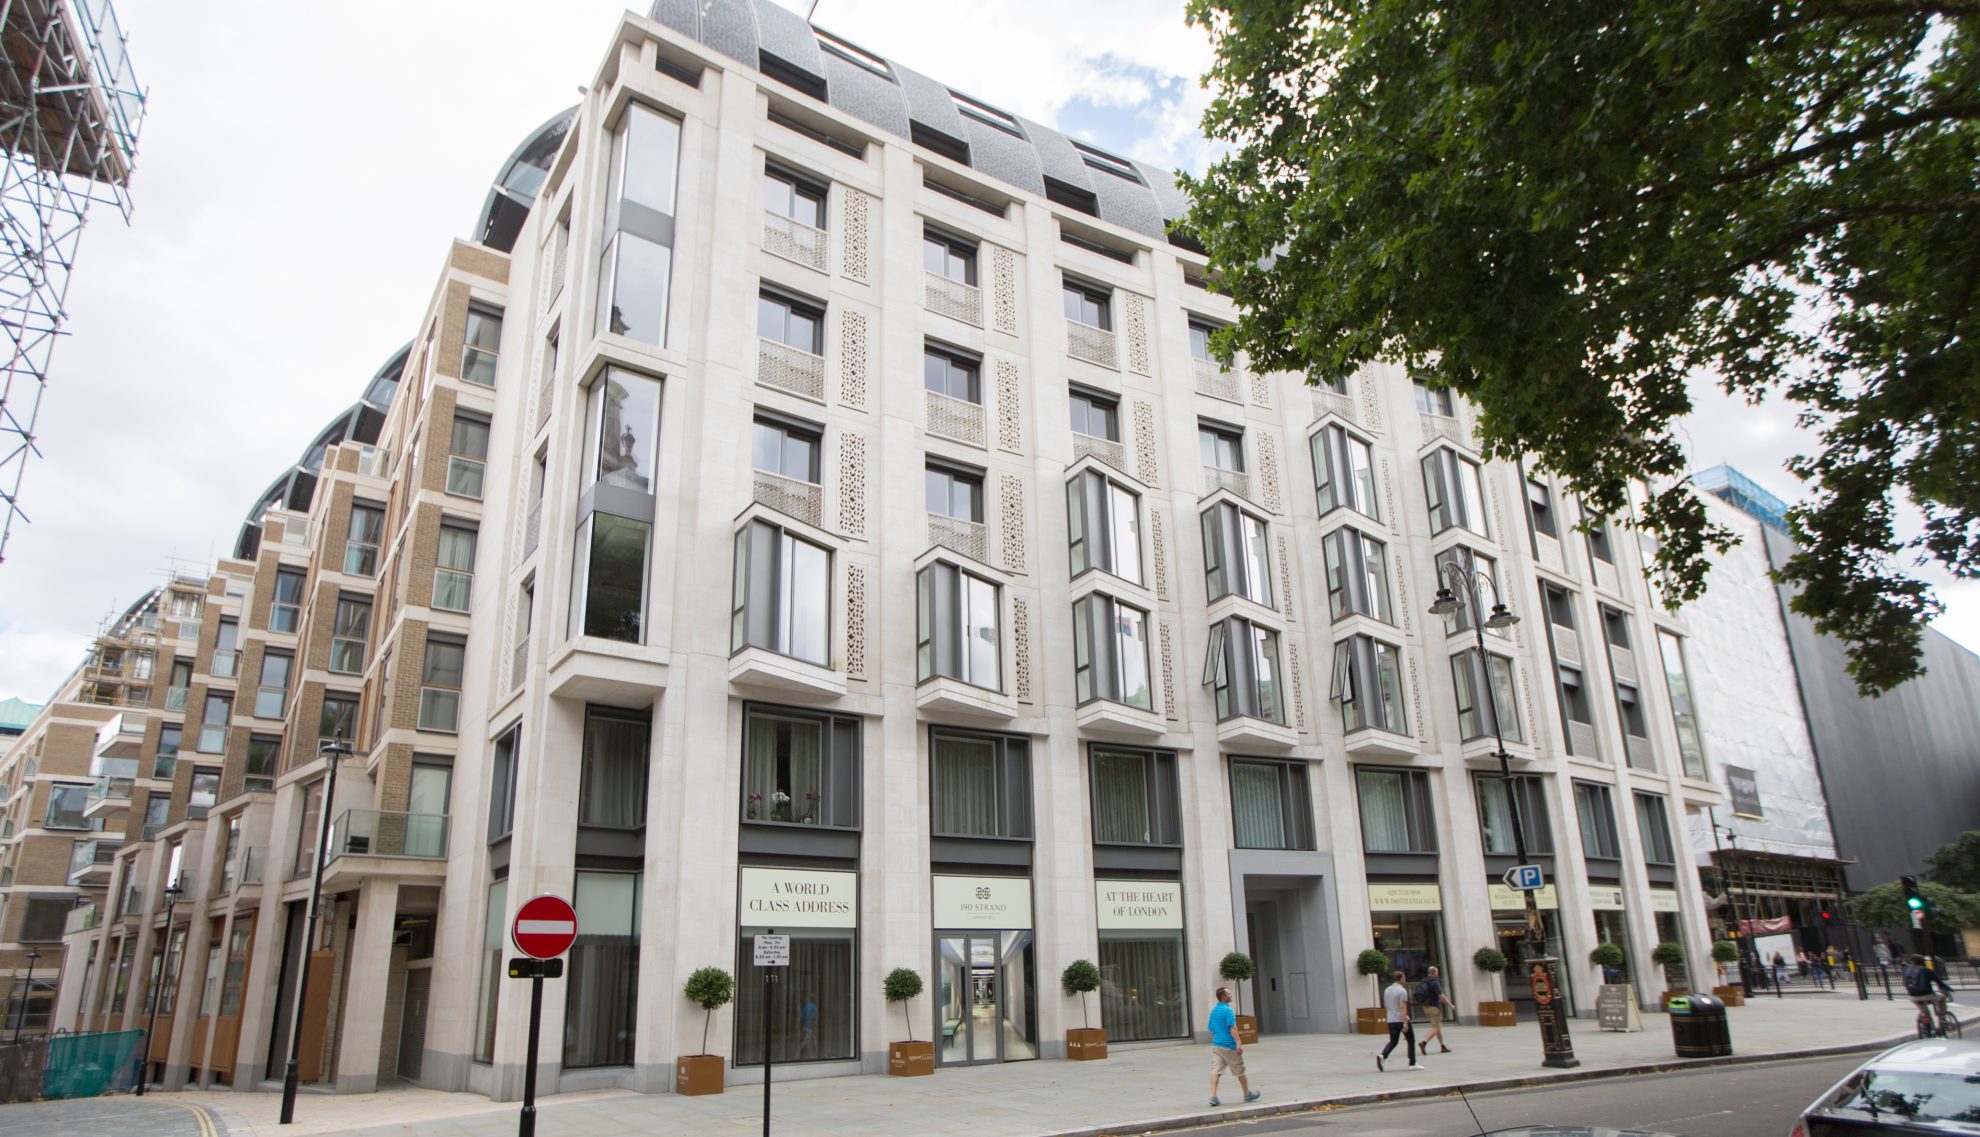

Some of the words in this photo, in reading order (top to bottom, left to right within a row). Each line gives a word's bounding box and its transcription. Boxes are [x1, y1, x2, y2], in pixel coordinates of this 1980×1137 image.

[1524, 869, 1537, 885] P
[771, 882, 780, 894] A
[784, 882, 829, 895] WORLD
[1105, 891, 1118, 902] AT
[1120, 891, 1140, 902] THE
[1142, 892, 1175, 903] HEART
[749, 899, 790, 912] CLASS
[792, 900, 849, 913] ADDRESS
[960, 903, 973, 911] 190
[975, 903, 1007, 912] STRAND
[1113, 906, 1126, 917] OF
[1128, 906, 1168, 917] LONDON
